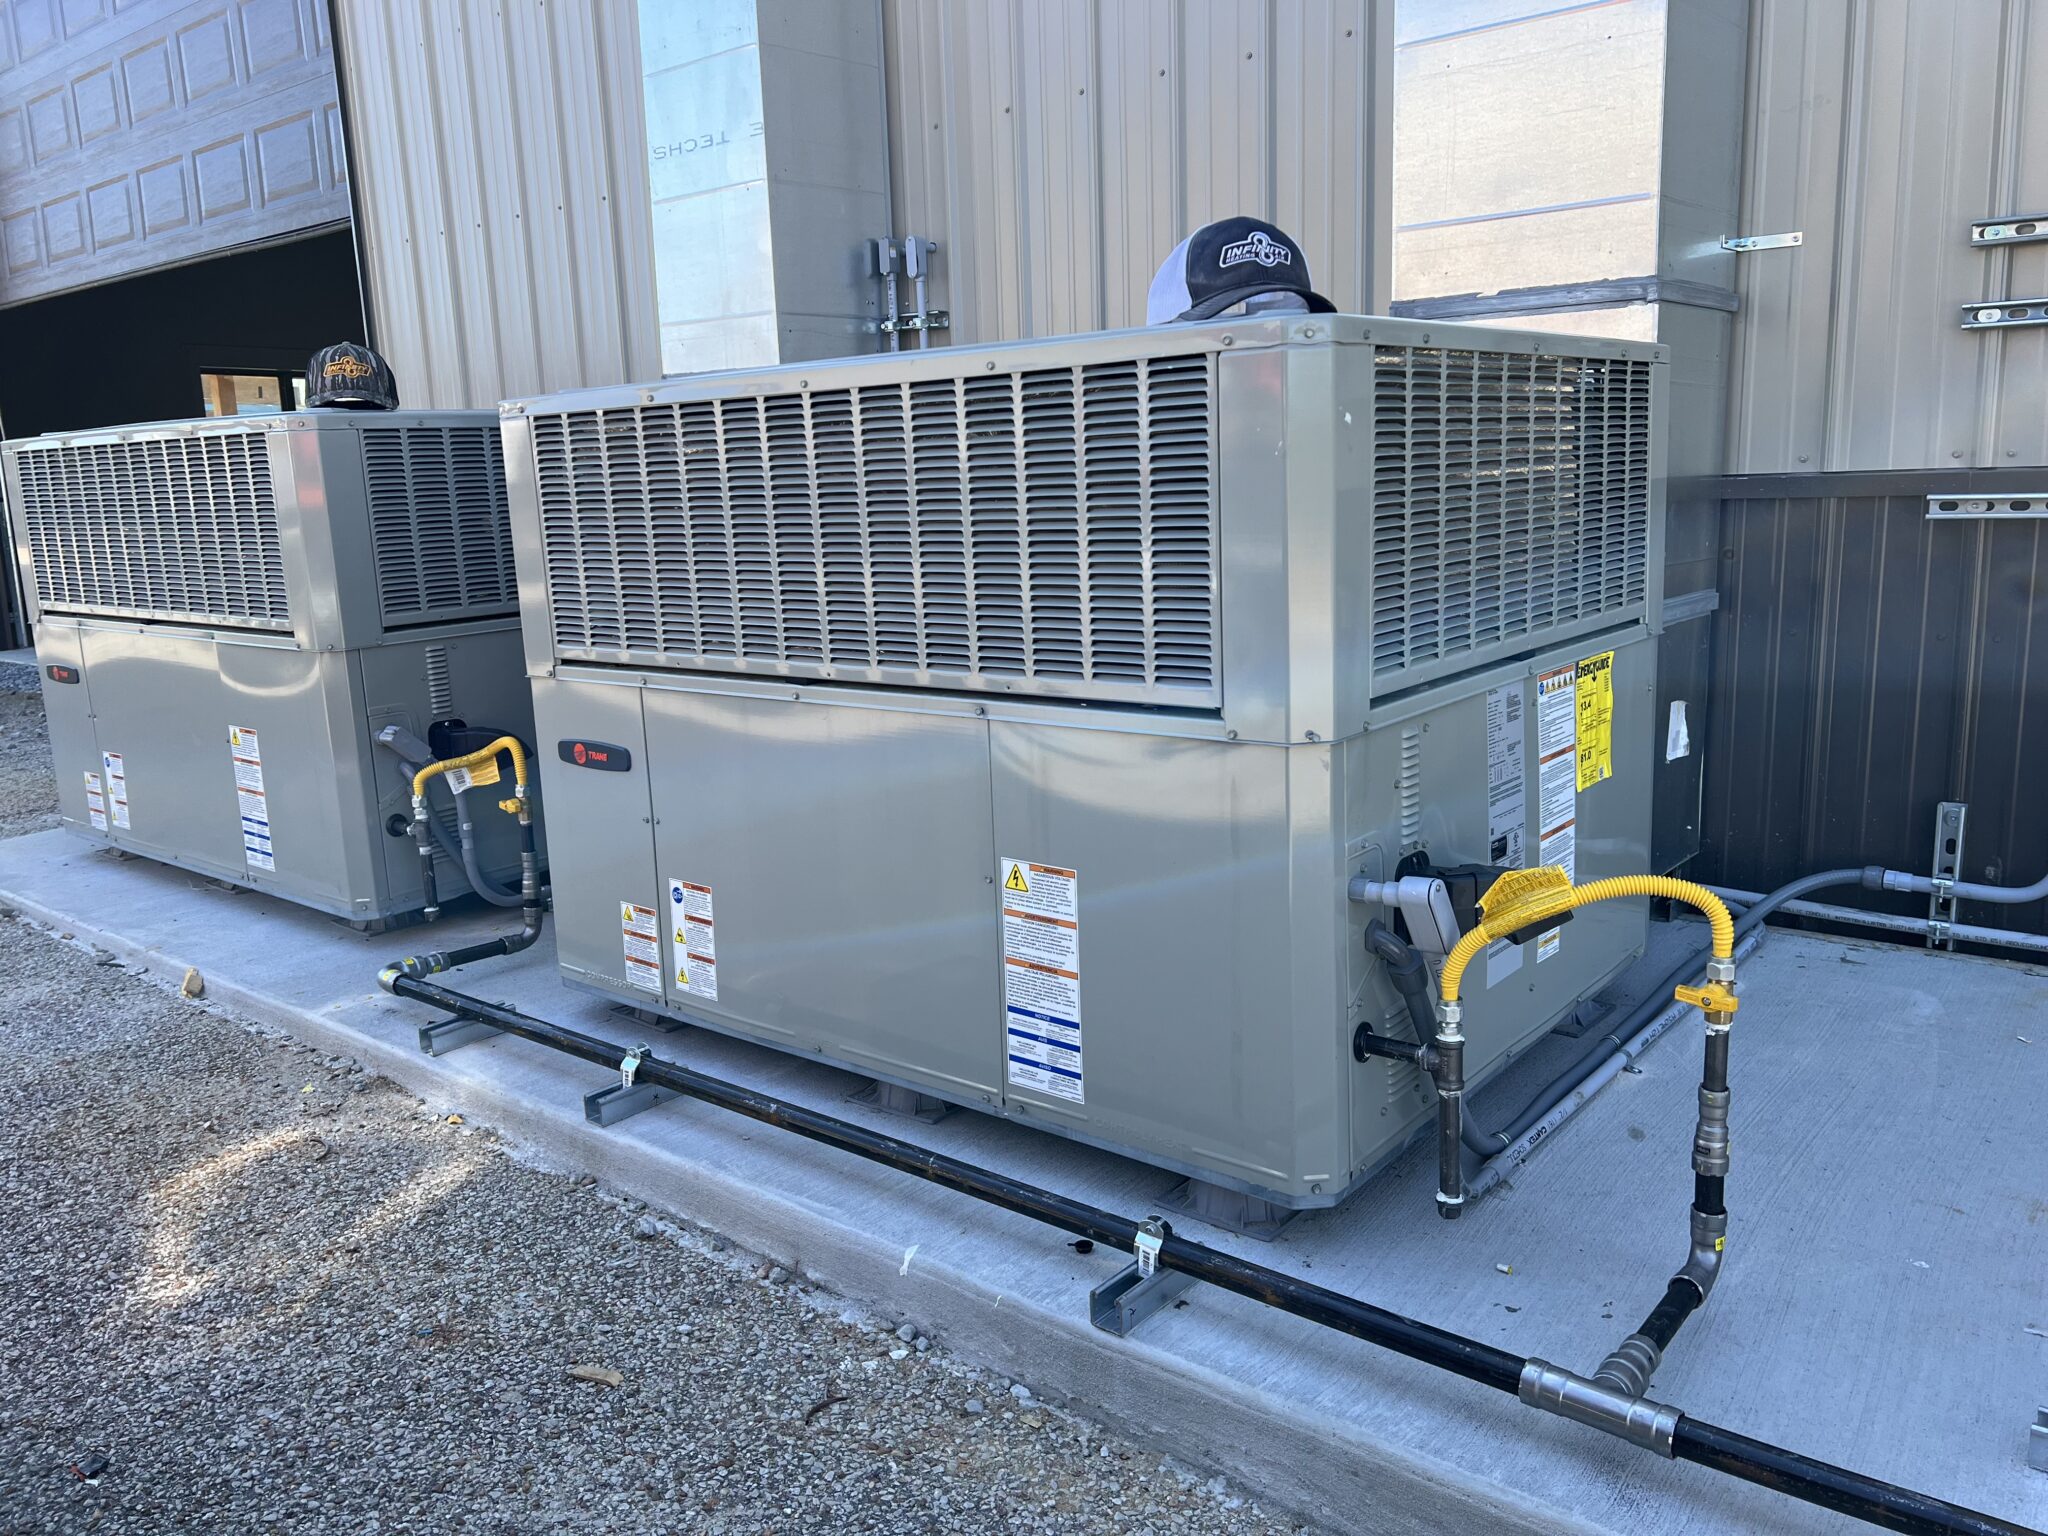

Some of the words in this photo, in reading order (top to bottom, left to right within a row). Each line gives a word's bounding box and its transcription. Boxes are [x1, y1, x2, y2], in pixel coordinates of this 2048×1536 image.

[653, 131, 731, 160] TECHS
[1227, 244, 1287, 257] INFINITY
[1226, 253, 1256, 263] HEATING
[588, 751, 608, 762] TRANE
[1034, 1013, 1051, 1021] NOTICE
[1038, 1063, 1052, 1071] AVISO
[1526, 1126, 1547, 1147] CANTEX
